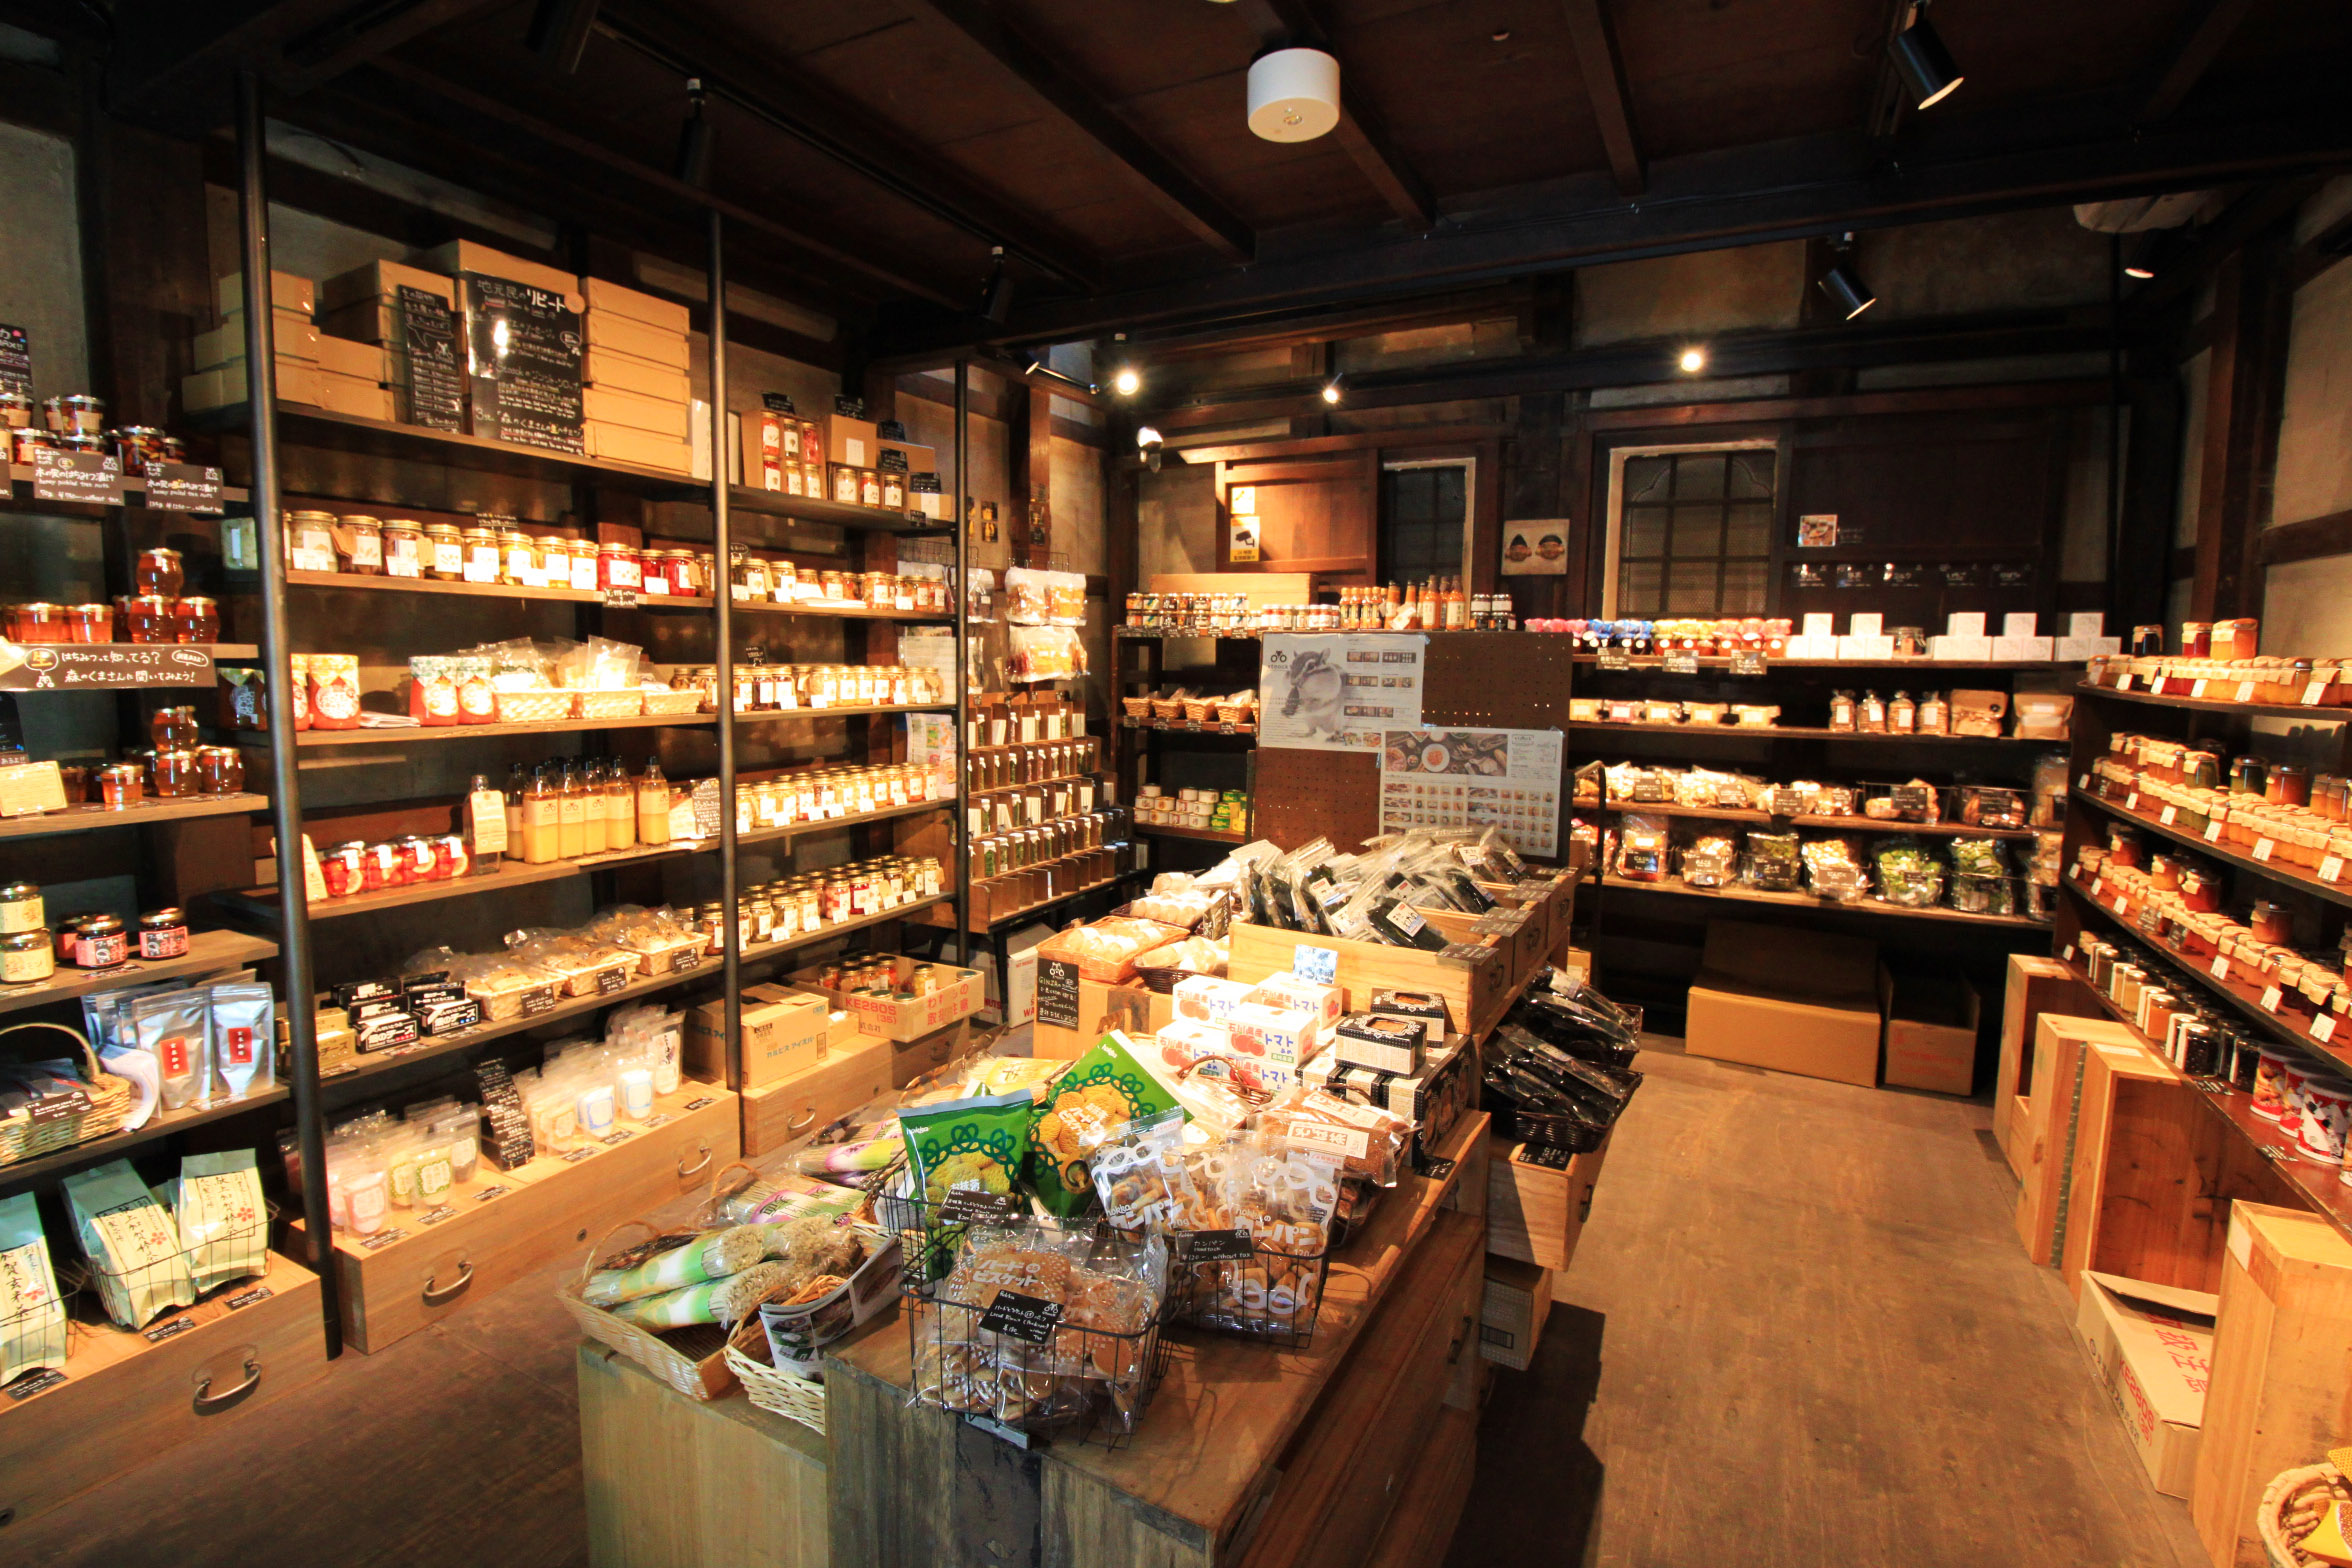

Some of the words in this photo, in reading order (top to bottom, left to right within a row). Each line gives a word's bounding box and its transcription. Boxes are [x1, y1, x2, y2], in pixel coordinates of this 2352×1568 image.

[64, 669, 196, 683] 森のくまさんに聞いてみよう!
[1177, 990, 1208, 1003] 石川県産
[1261, 989, 1292, 1003] 石川県産
[845, 996, 897, 1016] KE280S
[1209, 999, 1235, 1011] トマト
[1293, 1000, 1319, 1012] トマト
[1228, 1022, 1264, 1037] 石川県産
[1159, 1037, 1192, 1052] 石川県産
[1265, 1033, 1293, 1047] トマト
[1261, 1069, 1289, 1083] トマト
[1294, 1126, 1347, 1146] そば茶
[1109, 1199, 1185, 1229] カンパン
[1233, 1216, 1317, 1246] カンパン
[979, 1260, 1025, 1272] ハード
[973, 1270, 1039, 1287] ビスケット
